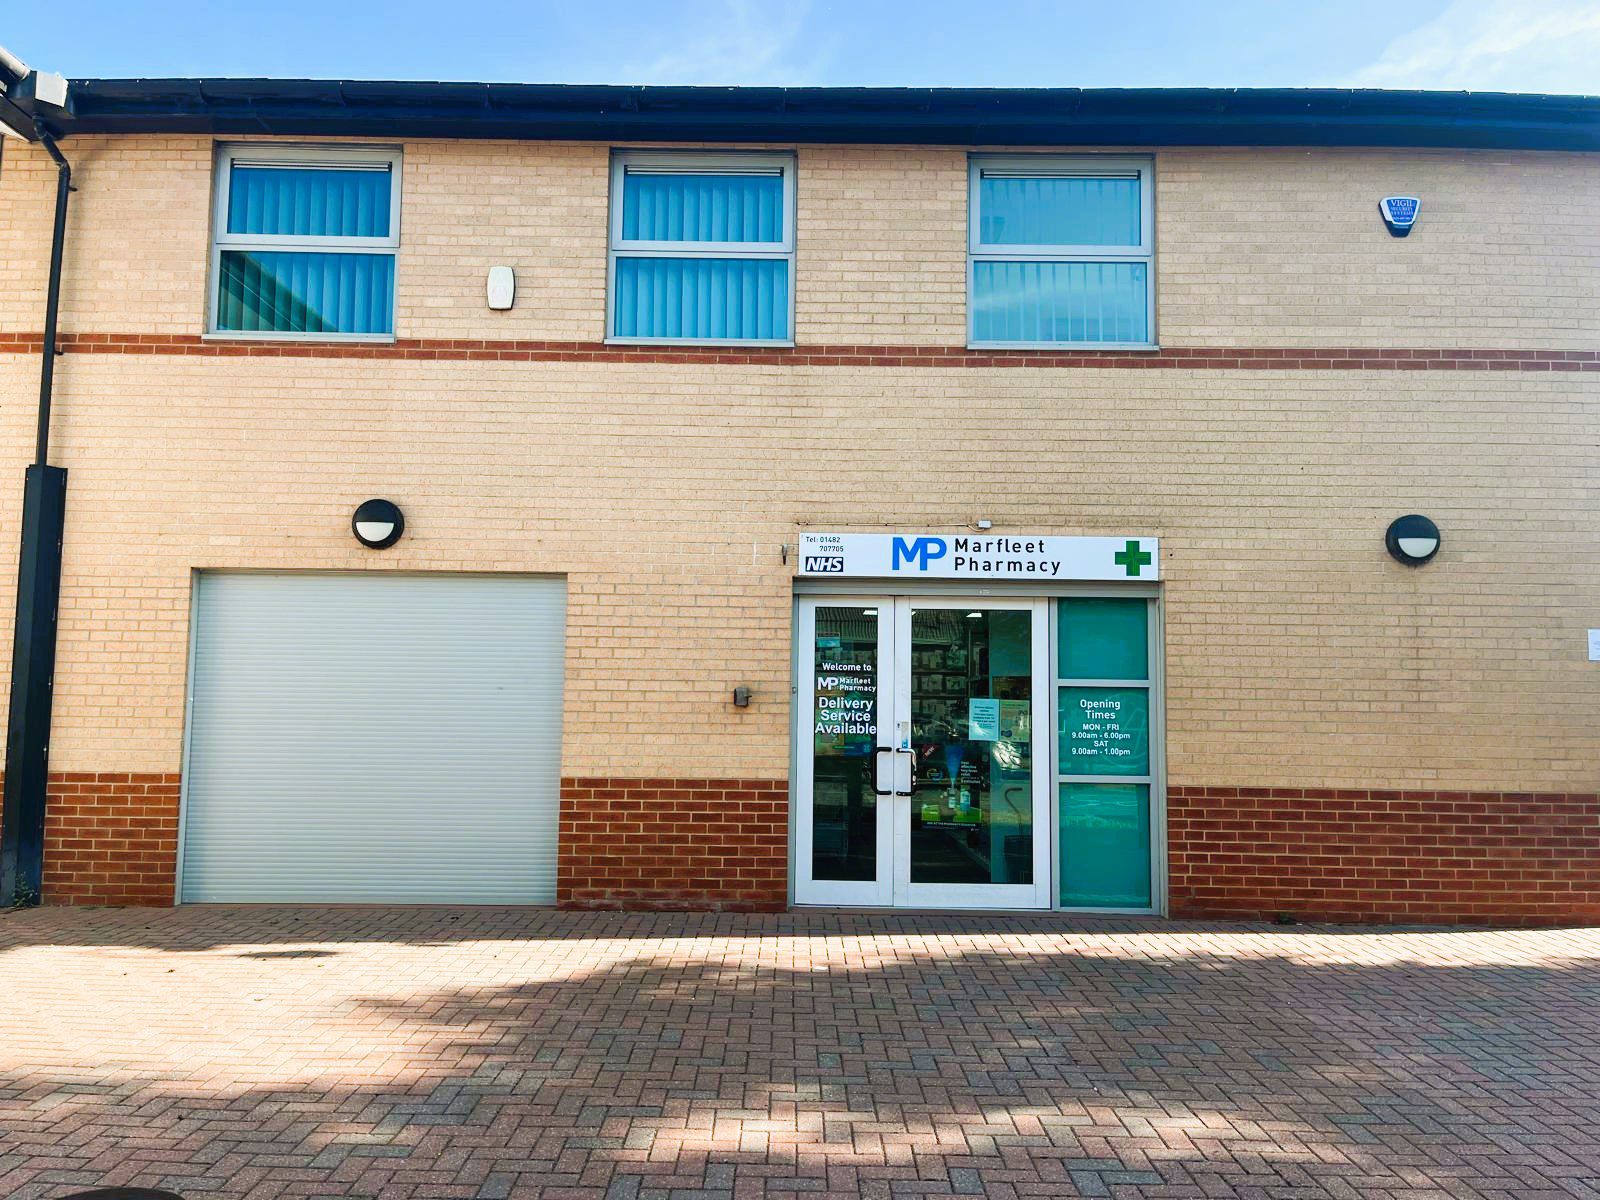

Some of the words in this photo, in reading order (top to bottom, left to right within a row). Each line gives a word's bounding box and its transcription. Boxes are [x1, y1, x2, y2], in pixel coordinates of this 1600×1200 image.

[954, 538, 1045, 553] Marfleet
[892, 537, 947, 571] MP
[806, 557, 843, 572] NHS
[954, 557, 1061, 576] Pharmacy
[822, 662, 861, 671] Welcome
[863, 663, 872, 671] to
[817, 676, 839, 690] MP
[839, 677, 871, 685] Marfleet
[839, 684, 876, 693] Pharmacy
[818, 696, 874, 712] Delivery
[1080, 699, 1120, 710] Opening
[820, 709, 871, 722] Service
[1085, 710, 1116, 719] Times
[815, 722, 877, 734] Available
[1104, 748, 1130, 756] 1.00pm
